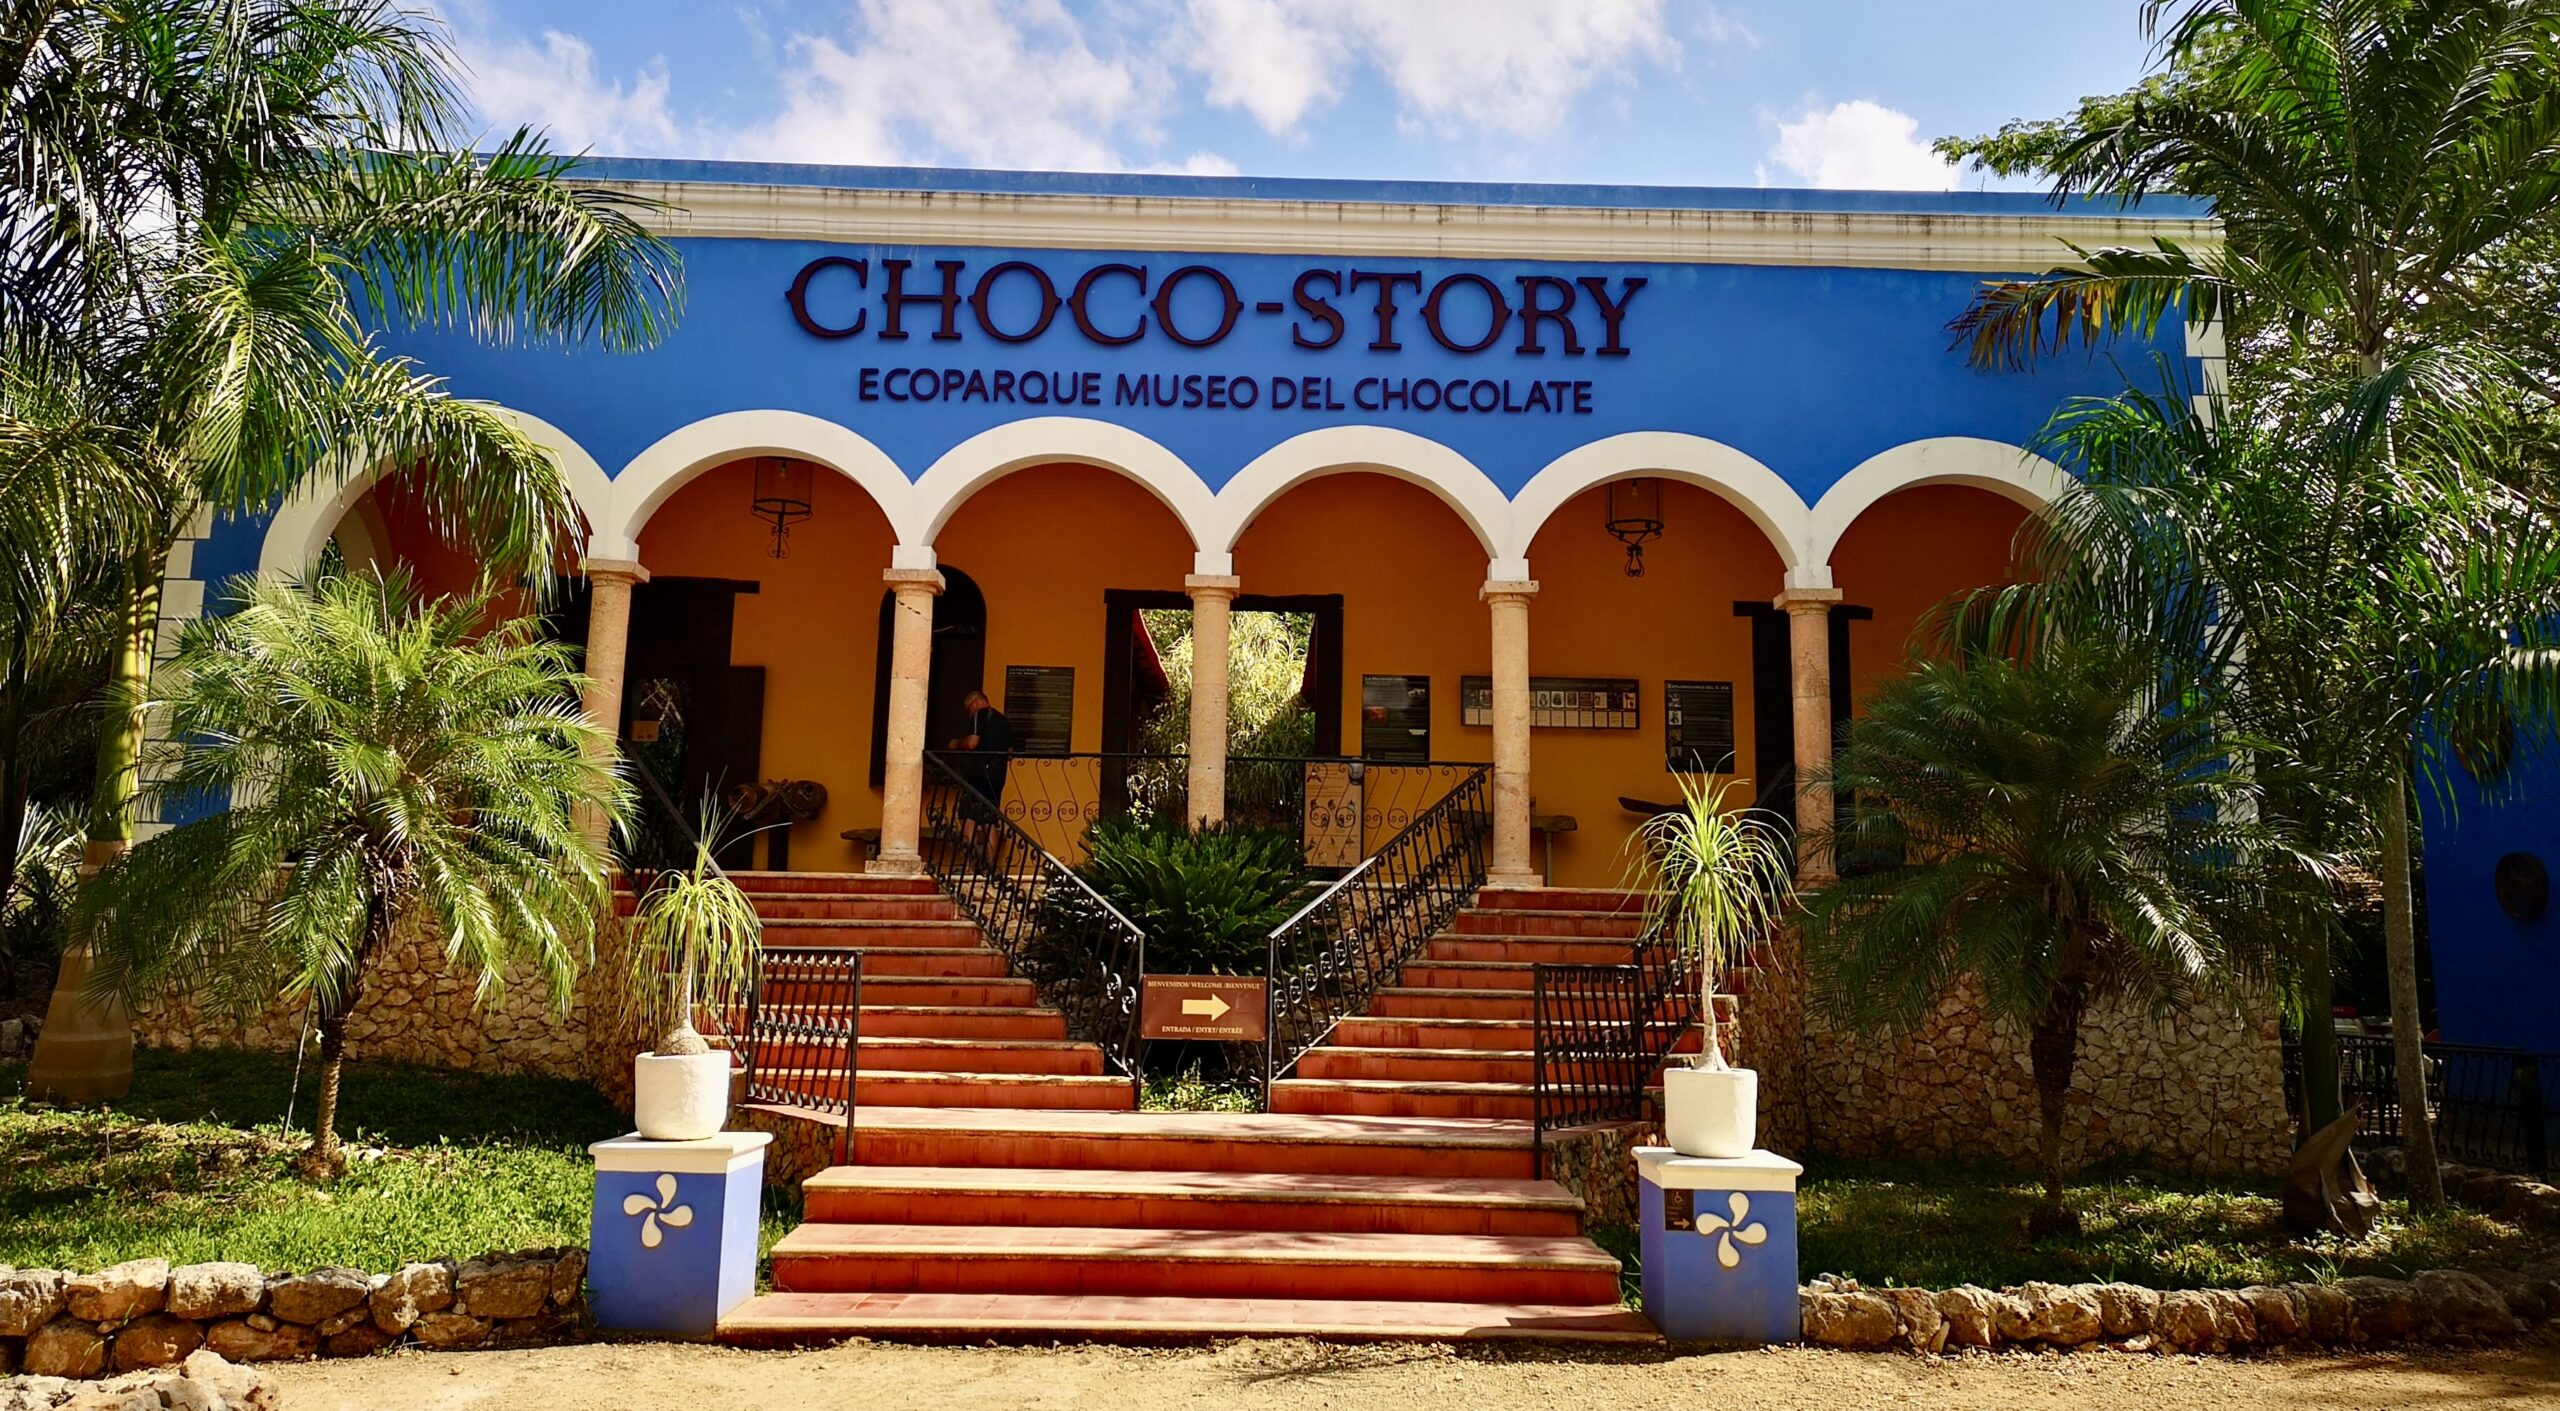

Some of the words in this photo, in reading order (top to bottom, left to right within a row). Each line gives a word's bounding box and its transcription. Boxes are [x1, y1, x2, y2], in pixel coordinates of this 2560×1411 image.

[785, 256, 1648, 358] CHOCO-STORY
[859, 369, 1100, 406] ECOPARQUE
[1116, 374, 1258, 409] MUSEO
[1272, 377, 1345, 411] DEL
[1354, 378, 1592, 414] CHOCOLATE
[1190, 981, 1223, 989] WELCOME
[1161, 1023, 1192, 1033] ENTRADA
